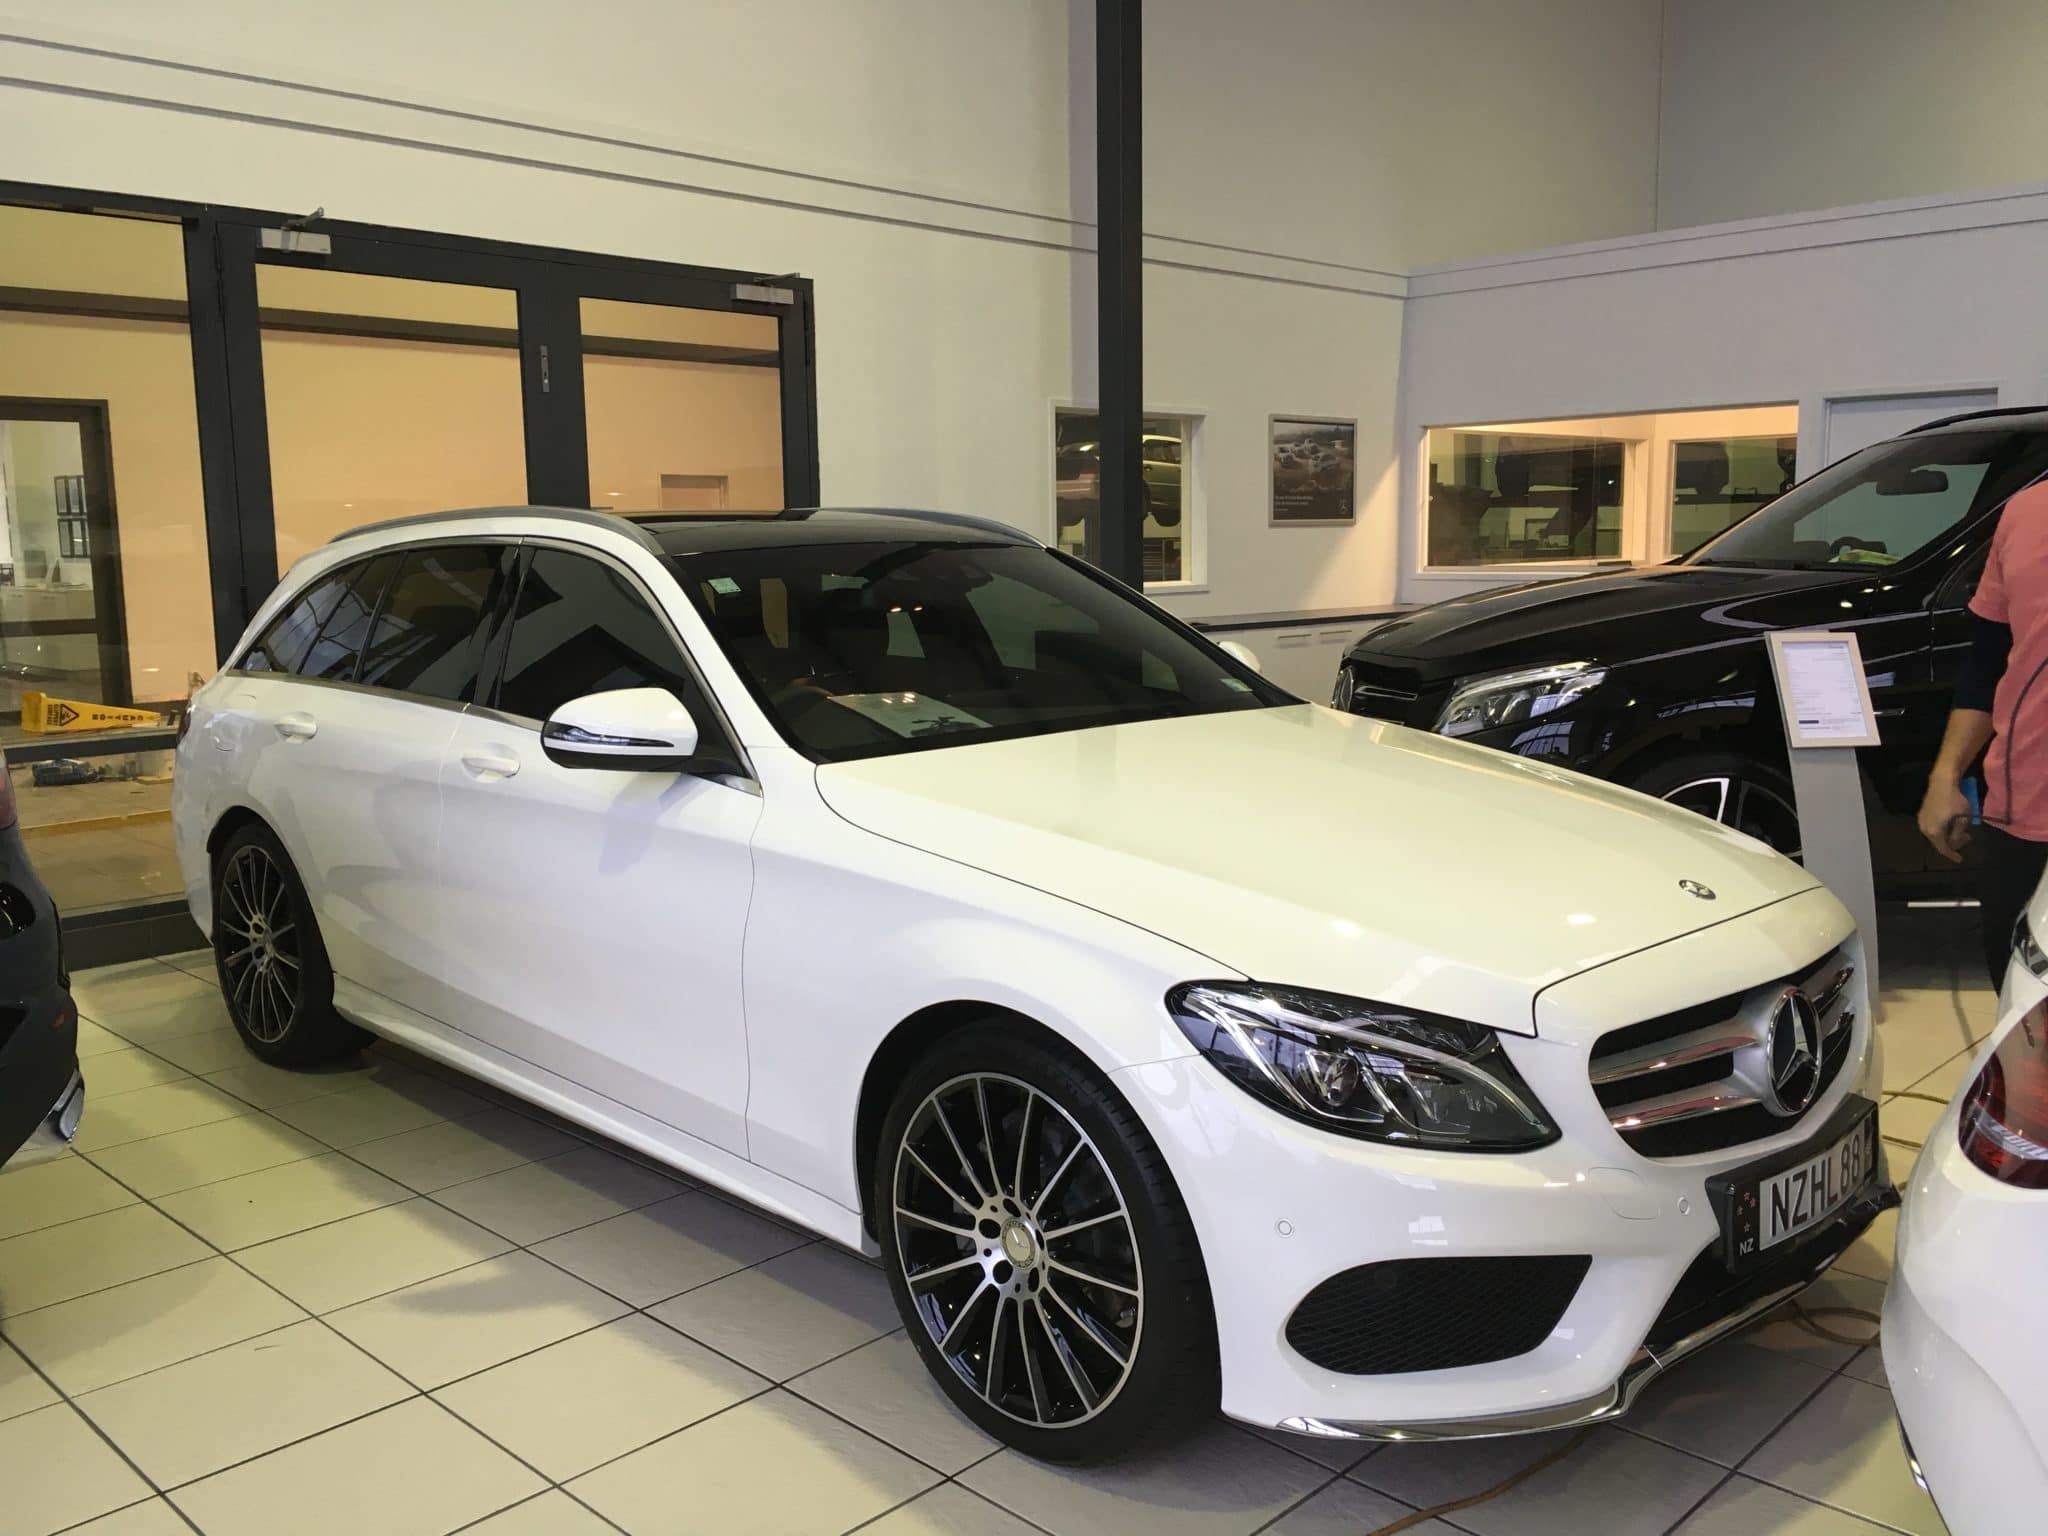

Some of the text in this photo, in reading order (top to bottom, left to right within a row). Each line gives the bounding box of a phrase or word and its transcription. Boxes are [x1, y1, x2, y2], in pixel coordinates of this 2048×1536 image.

[92, 713, 144, 721] CAUTION
[1771, 1134, 1861, 1237] NZHL88
[1739, 1237, 1754, 1257] NZ
